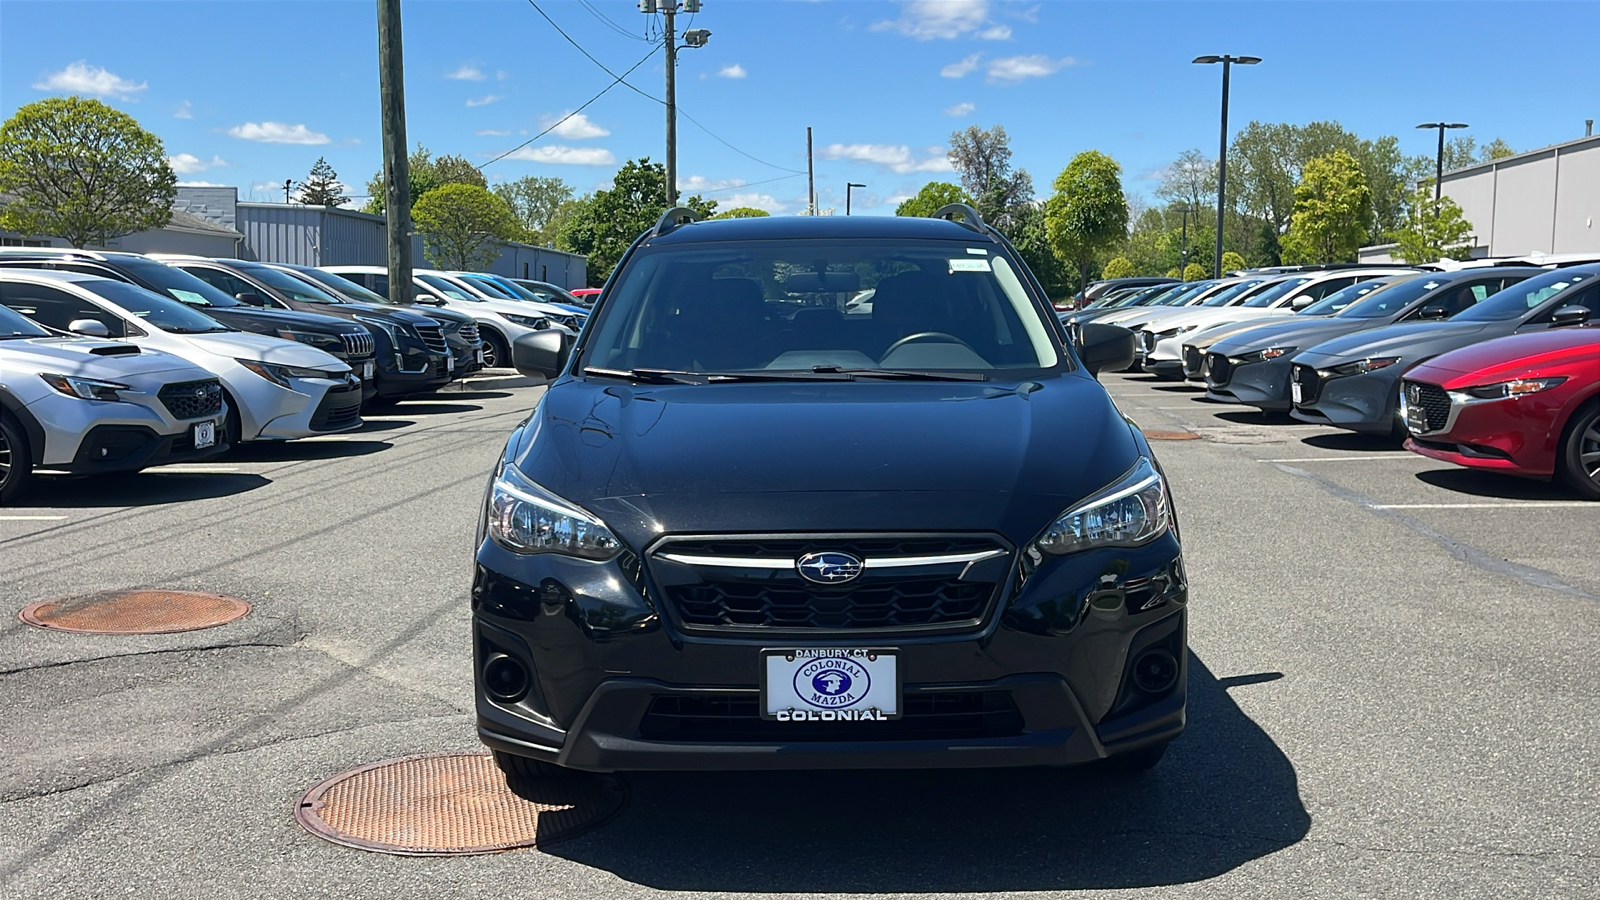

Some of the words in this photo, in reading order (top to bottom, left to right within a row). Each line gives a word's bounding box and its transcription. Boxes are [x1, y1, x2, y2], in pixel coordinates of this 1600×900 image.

[853, 649, 868, 658] CT
[803, 660, 860, 678] COLONIAL
[811, 693, 855, 705] MAZDA
[776, 710, 887, 721] COLONIAL
